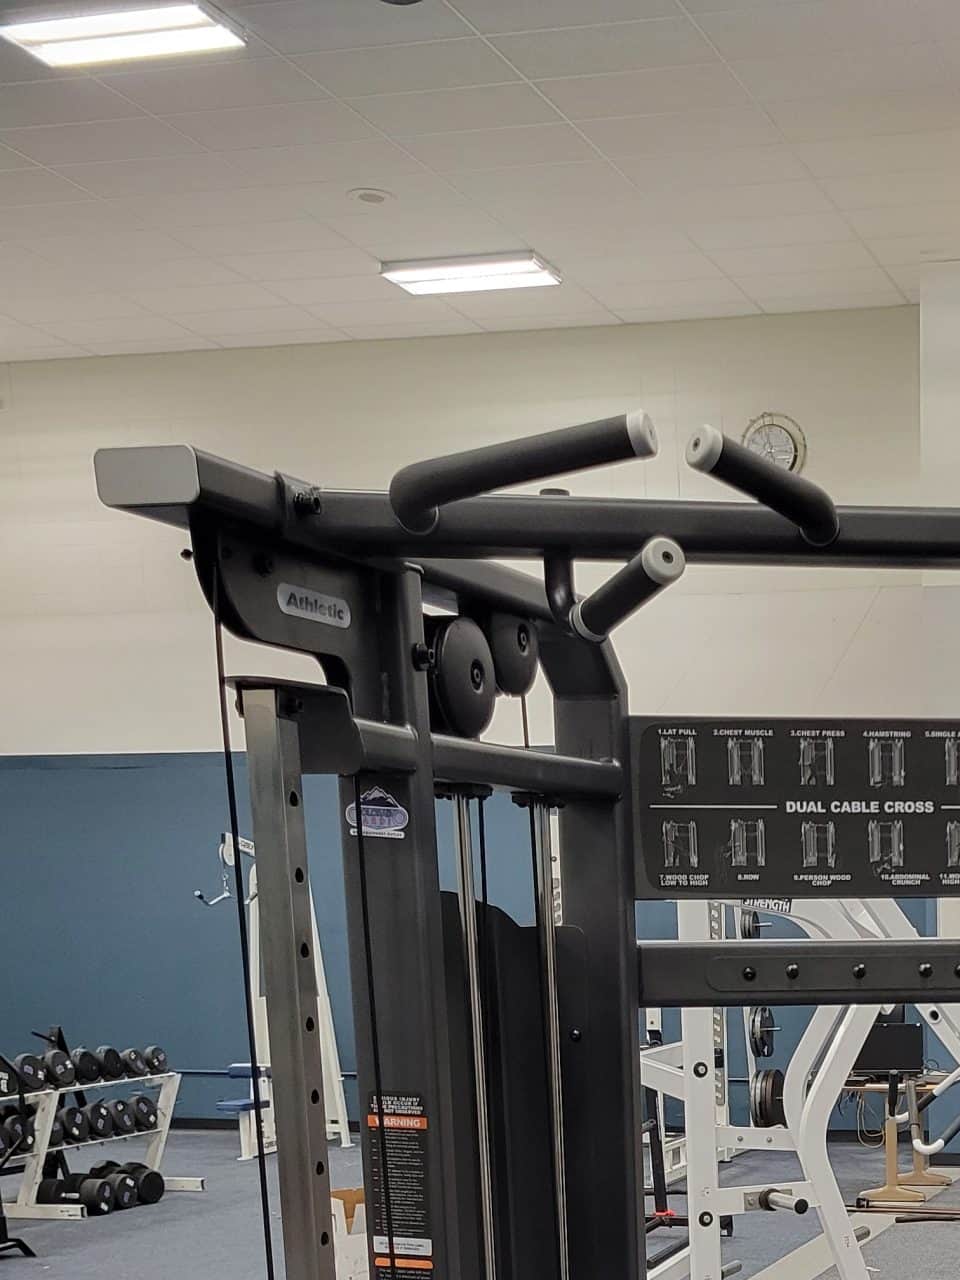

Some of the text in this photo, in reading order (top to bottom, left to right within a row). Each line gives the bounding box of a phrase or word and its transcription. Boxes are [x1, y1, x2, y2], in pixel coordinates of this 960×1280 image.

[286, 591, 344, 621] Athletic
[785, 801, 935, 813] DUAL CABLE CROSS
